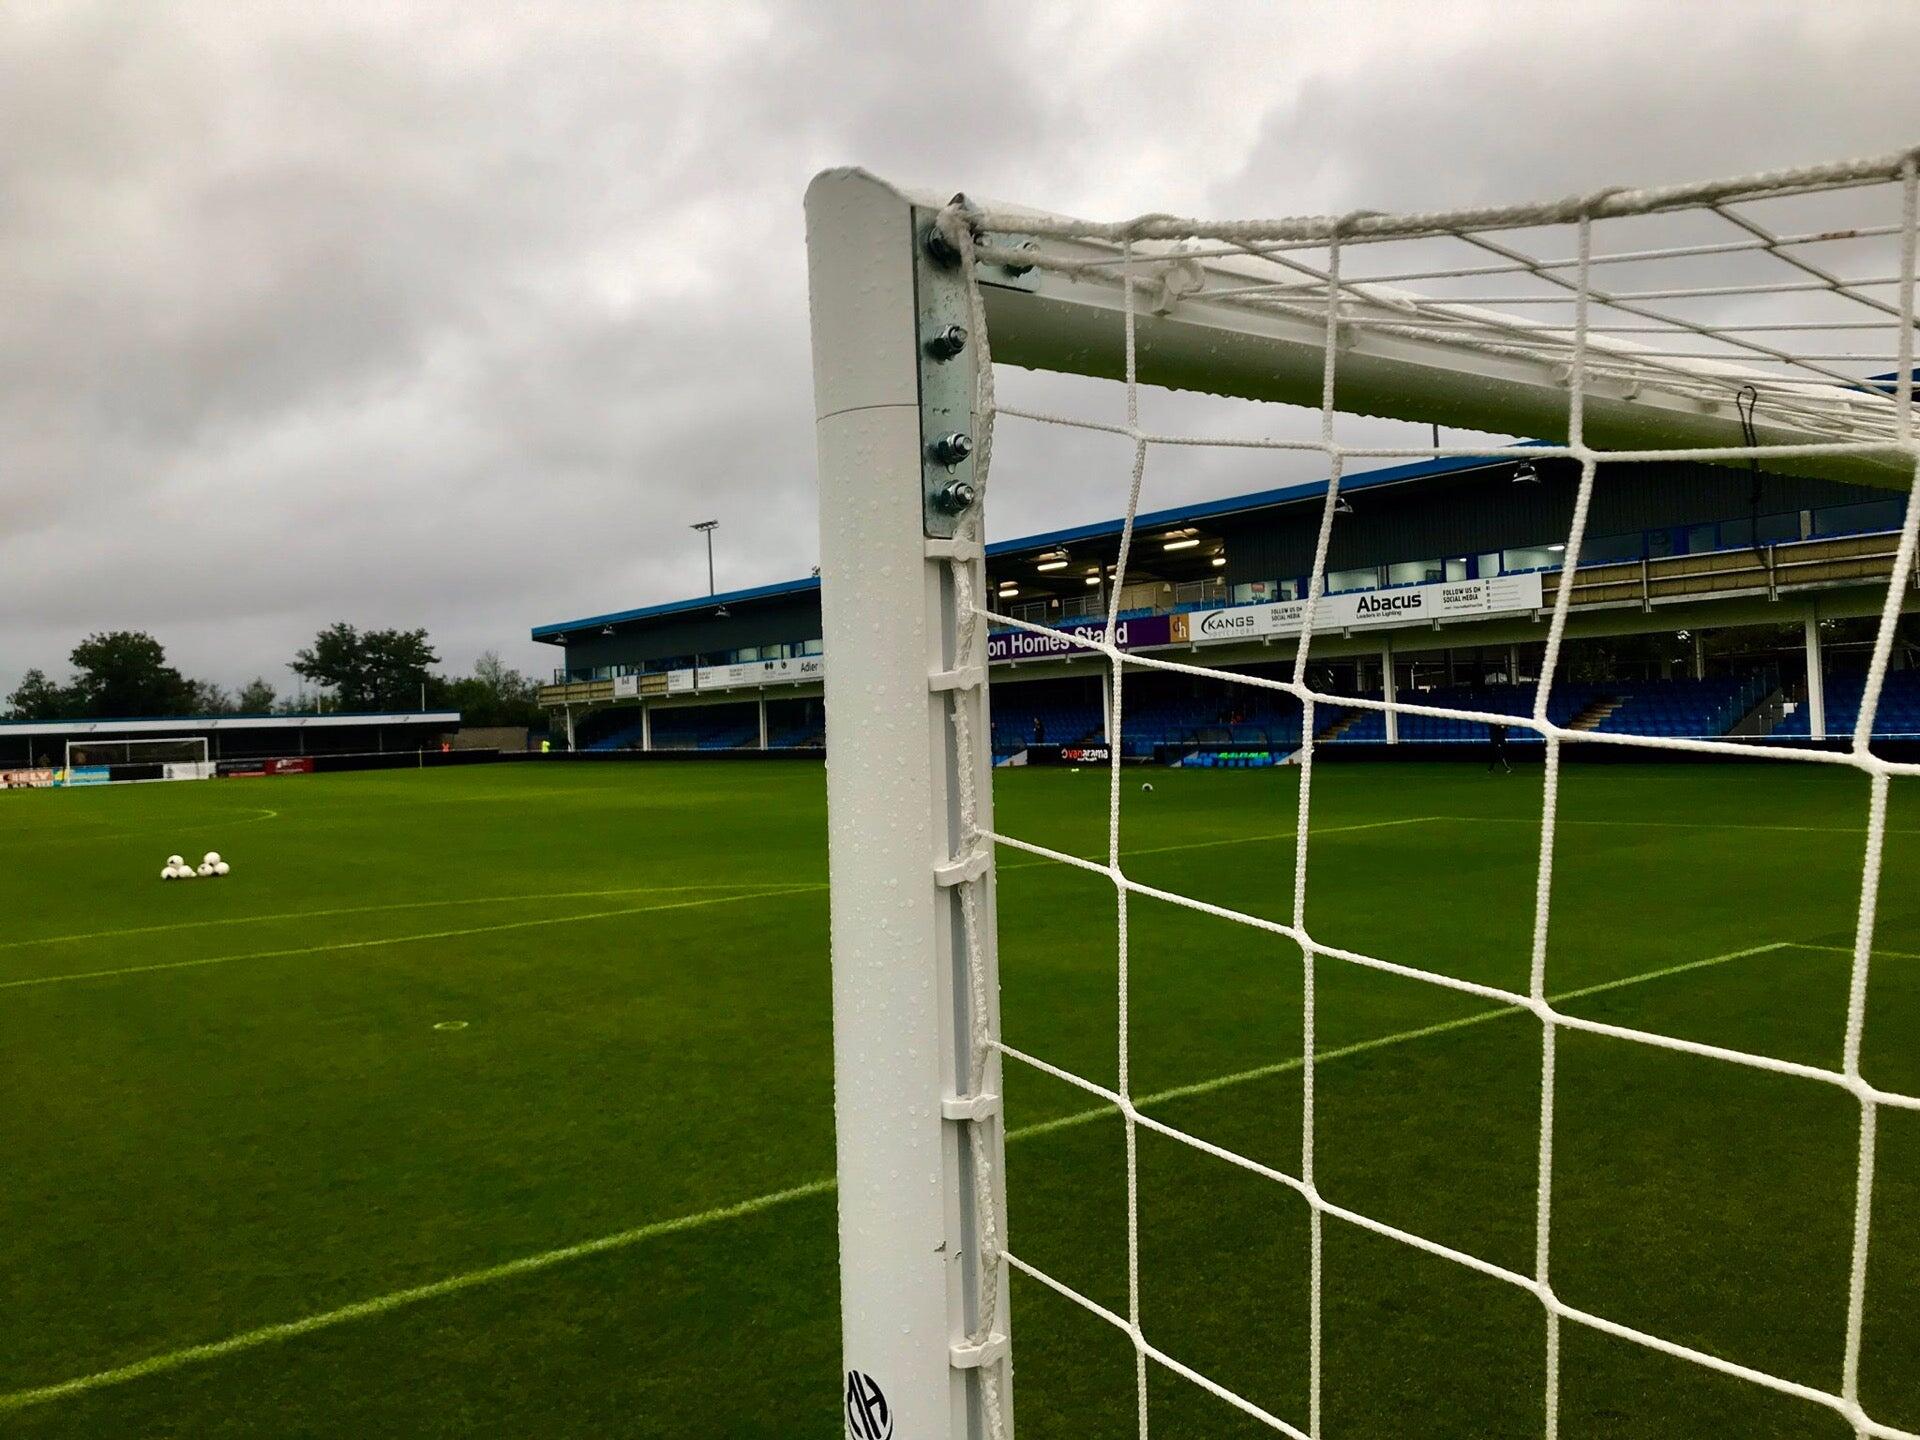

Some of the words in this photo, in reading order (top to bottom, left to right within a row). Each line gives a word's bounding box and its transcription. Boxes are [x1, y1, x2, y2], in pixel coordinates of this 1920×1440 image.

[1356, 594, 1422, 613] Abacus
[1382, 610, 1402, 618] Lighting
[1208, 616, 1254, 630] KANGS
[1011, 634, 1070, 654] Homes
[1074, 622, 1128, 648] Stad
[1068, 749, 1108, 759] vanarama
